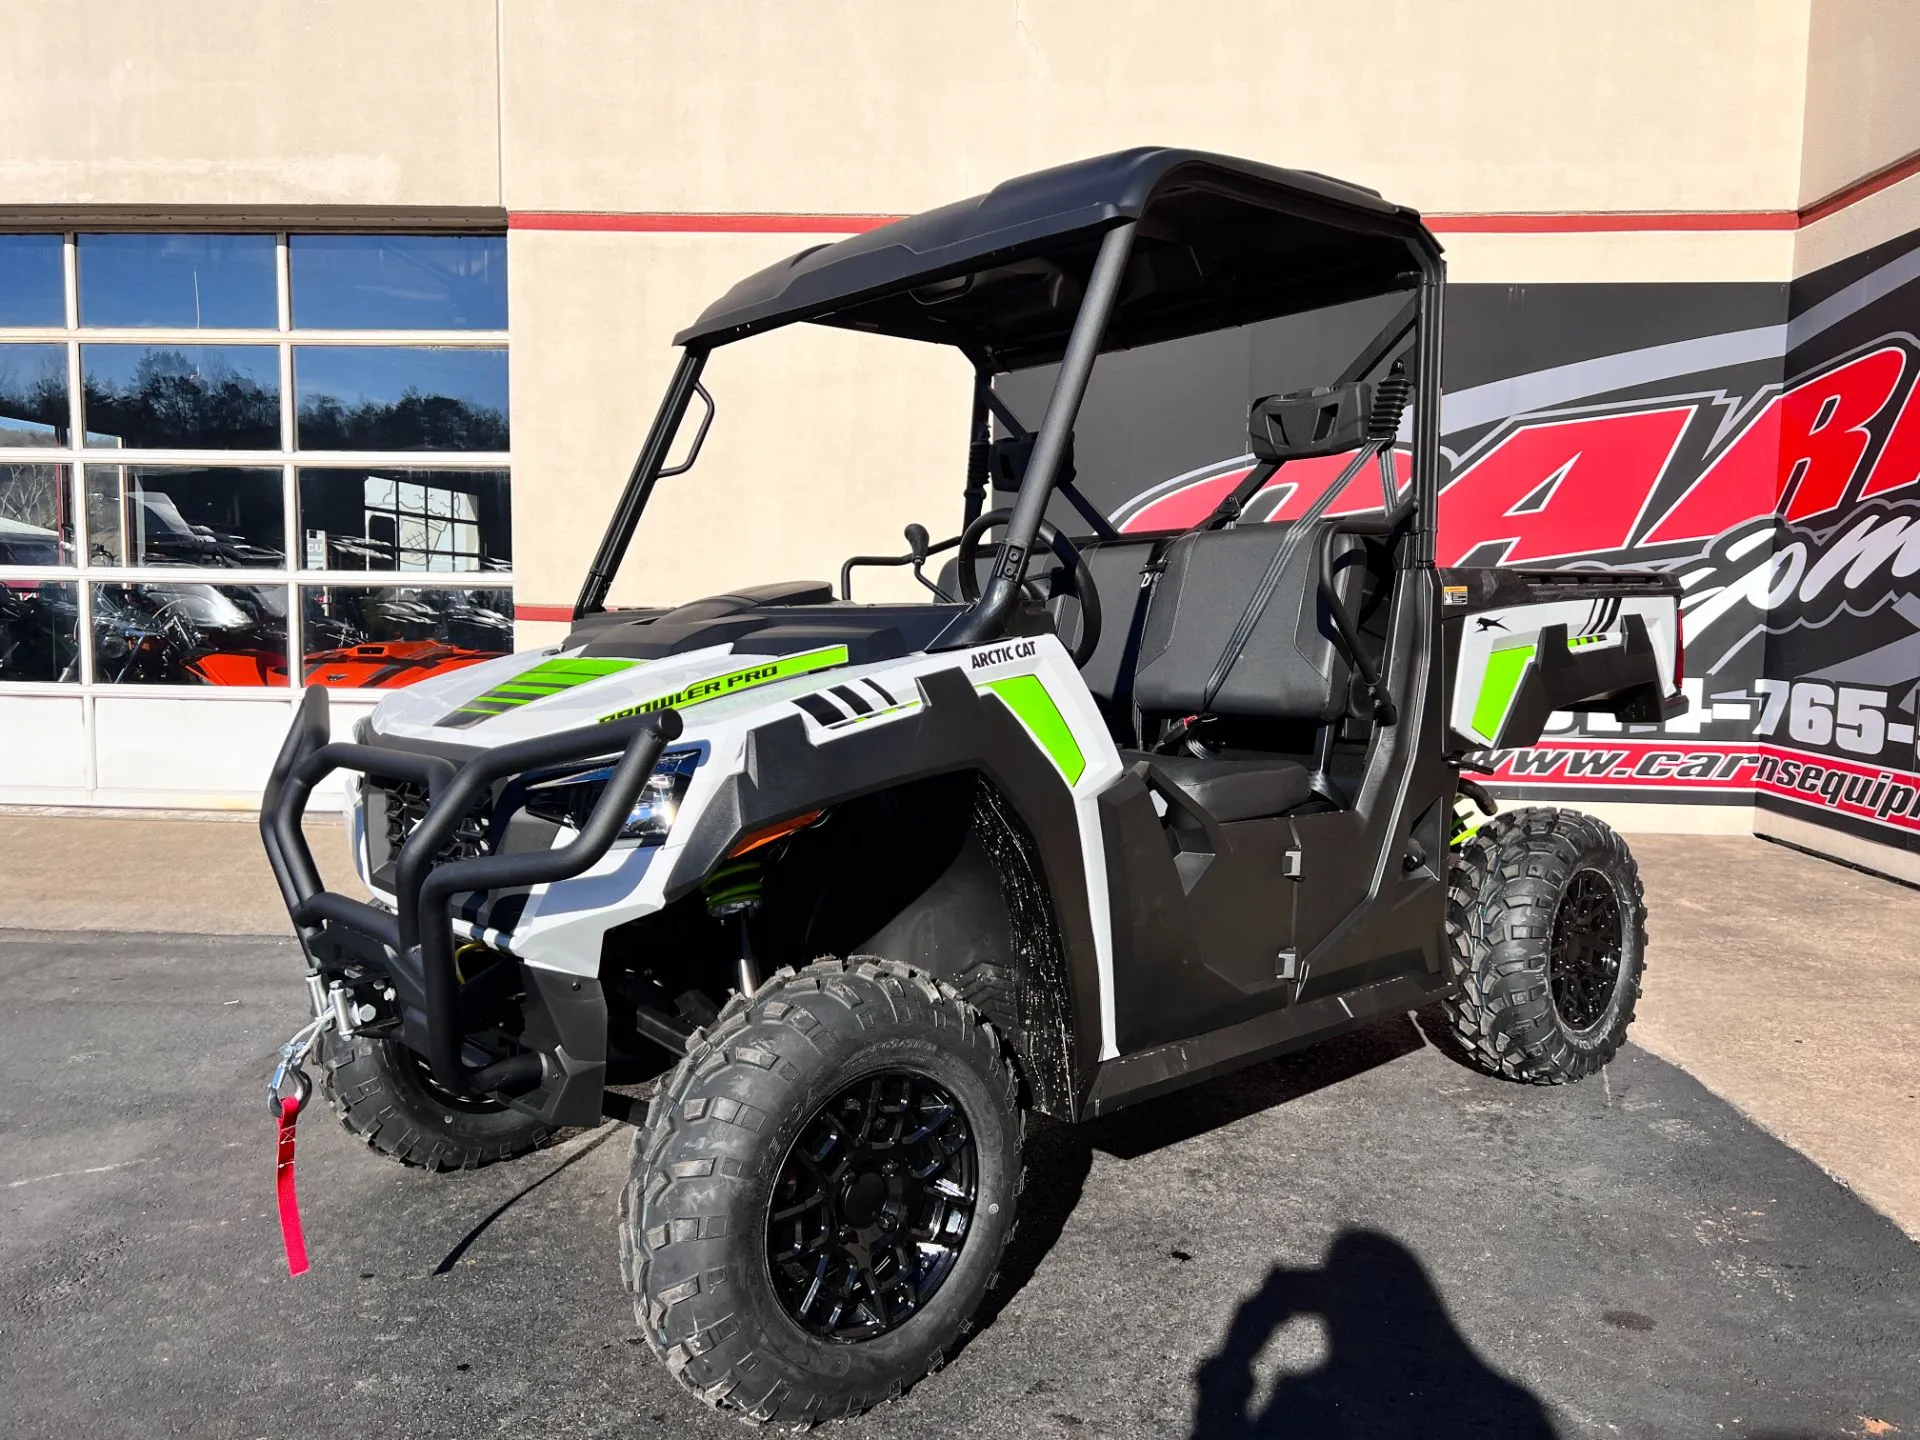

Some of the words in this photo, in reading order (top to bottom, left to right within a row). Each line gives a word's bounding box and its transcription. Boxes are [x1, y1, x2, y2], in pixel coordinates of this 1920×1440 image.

[971, 646, 1015, 669] ARCTIC
[1015, 640, 1037, 659] CAT
[728, 665, 778, 688] PRO
